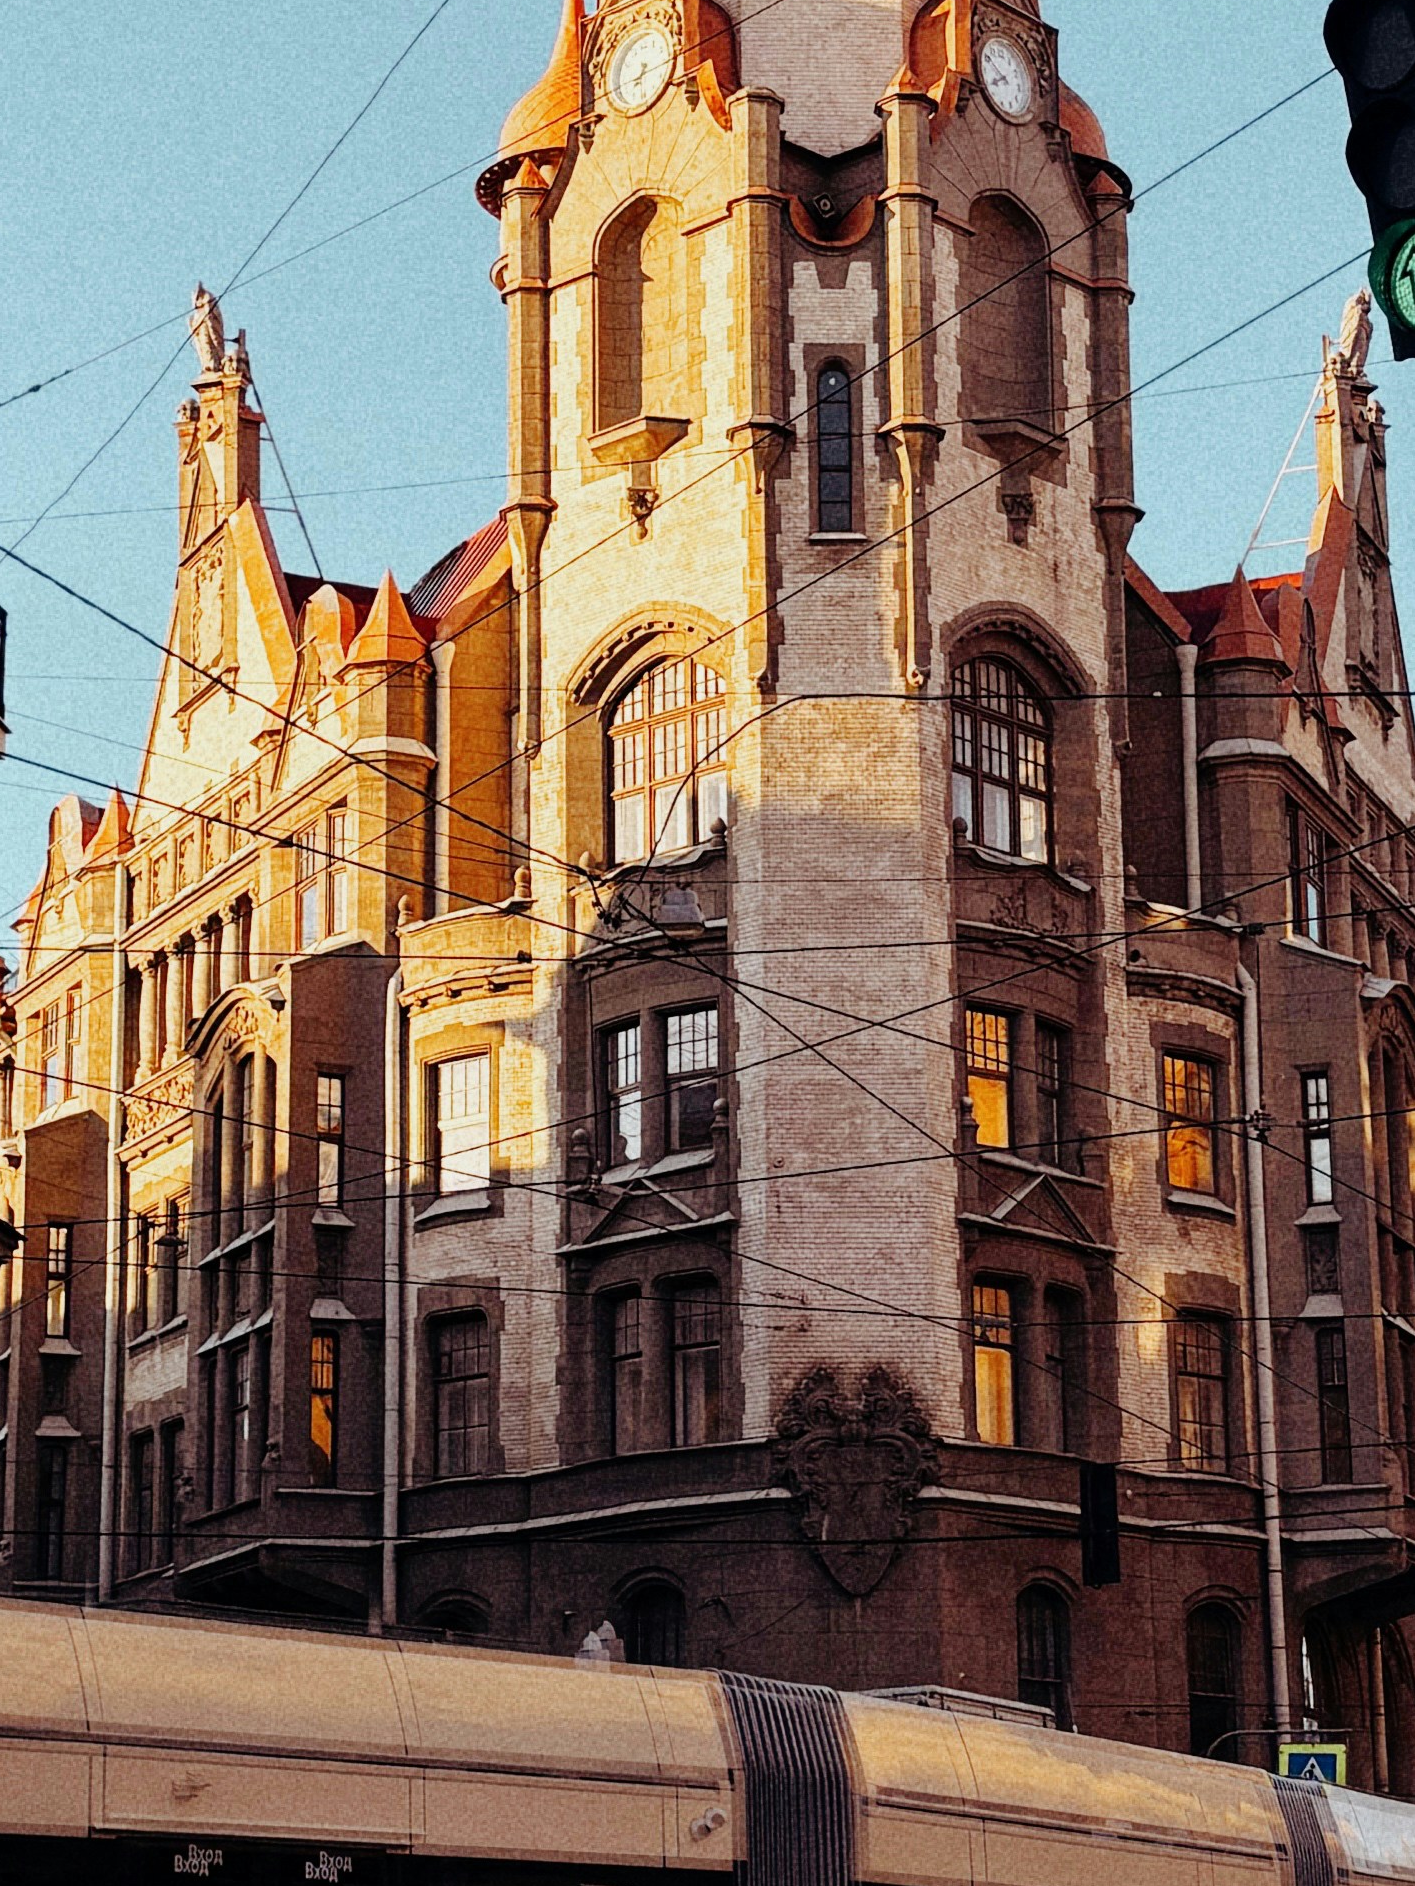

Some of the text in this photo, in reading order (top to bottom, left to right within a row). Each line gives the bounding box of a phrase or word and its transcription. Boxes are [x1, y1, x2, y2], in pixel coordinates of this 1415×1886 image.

[174, 1854, 209, 1876] Вход
[188, 1844, 223, 1866] Вход
[319, 1851, 352, 1872] Вход
[305, 1861, 338, 1883] Вход
